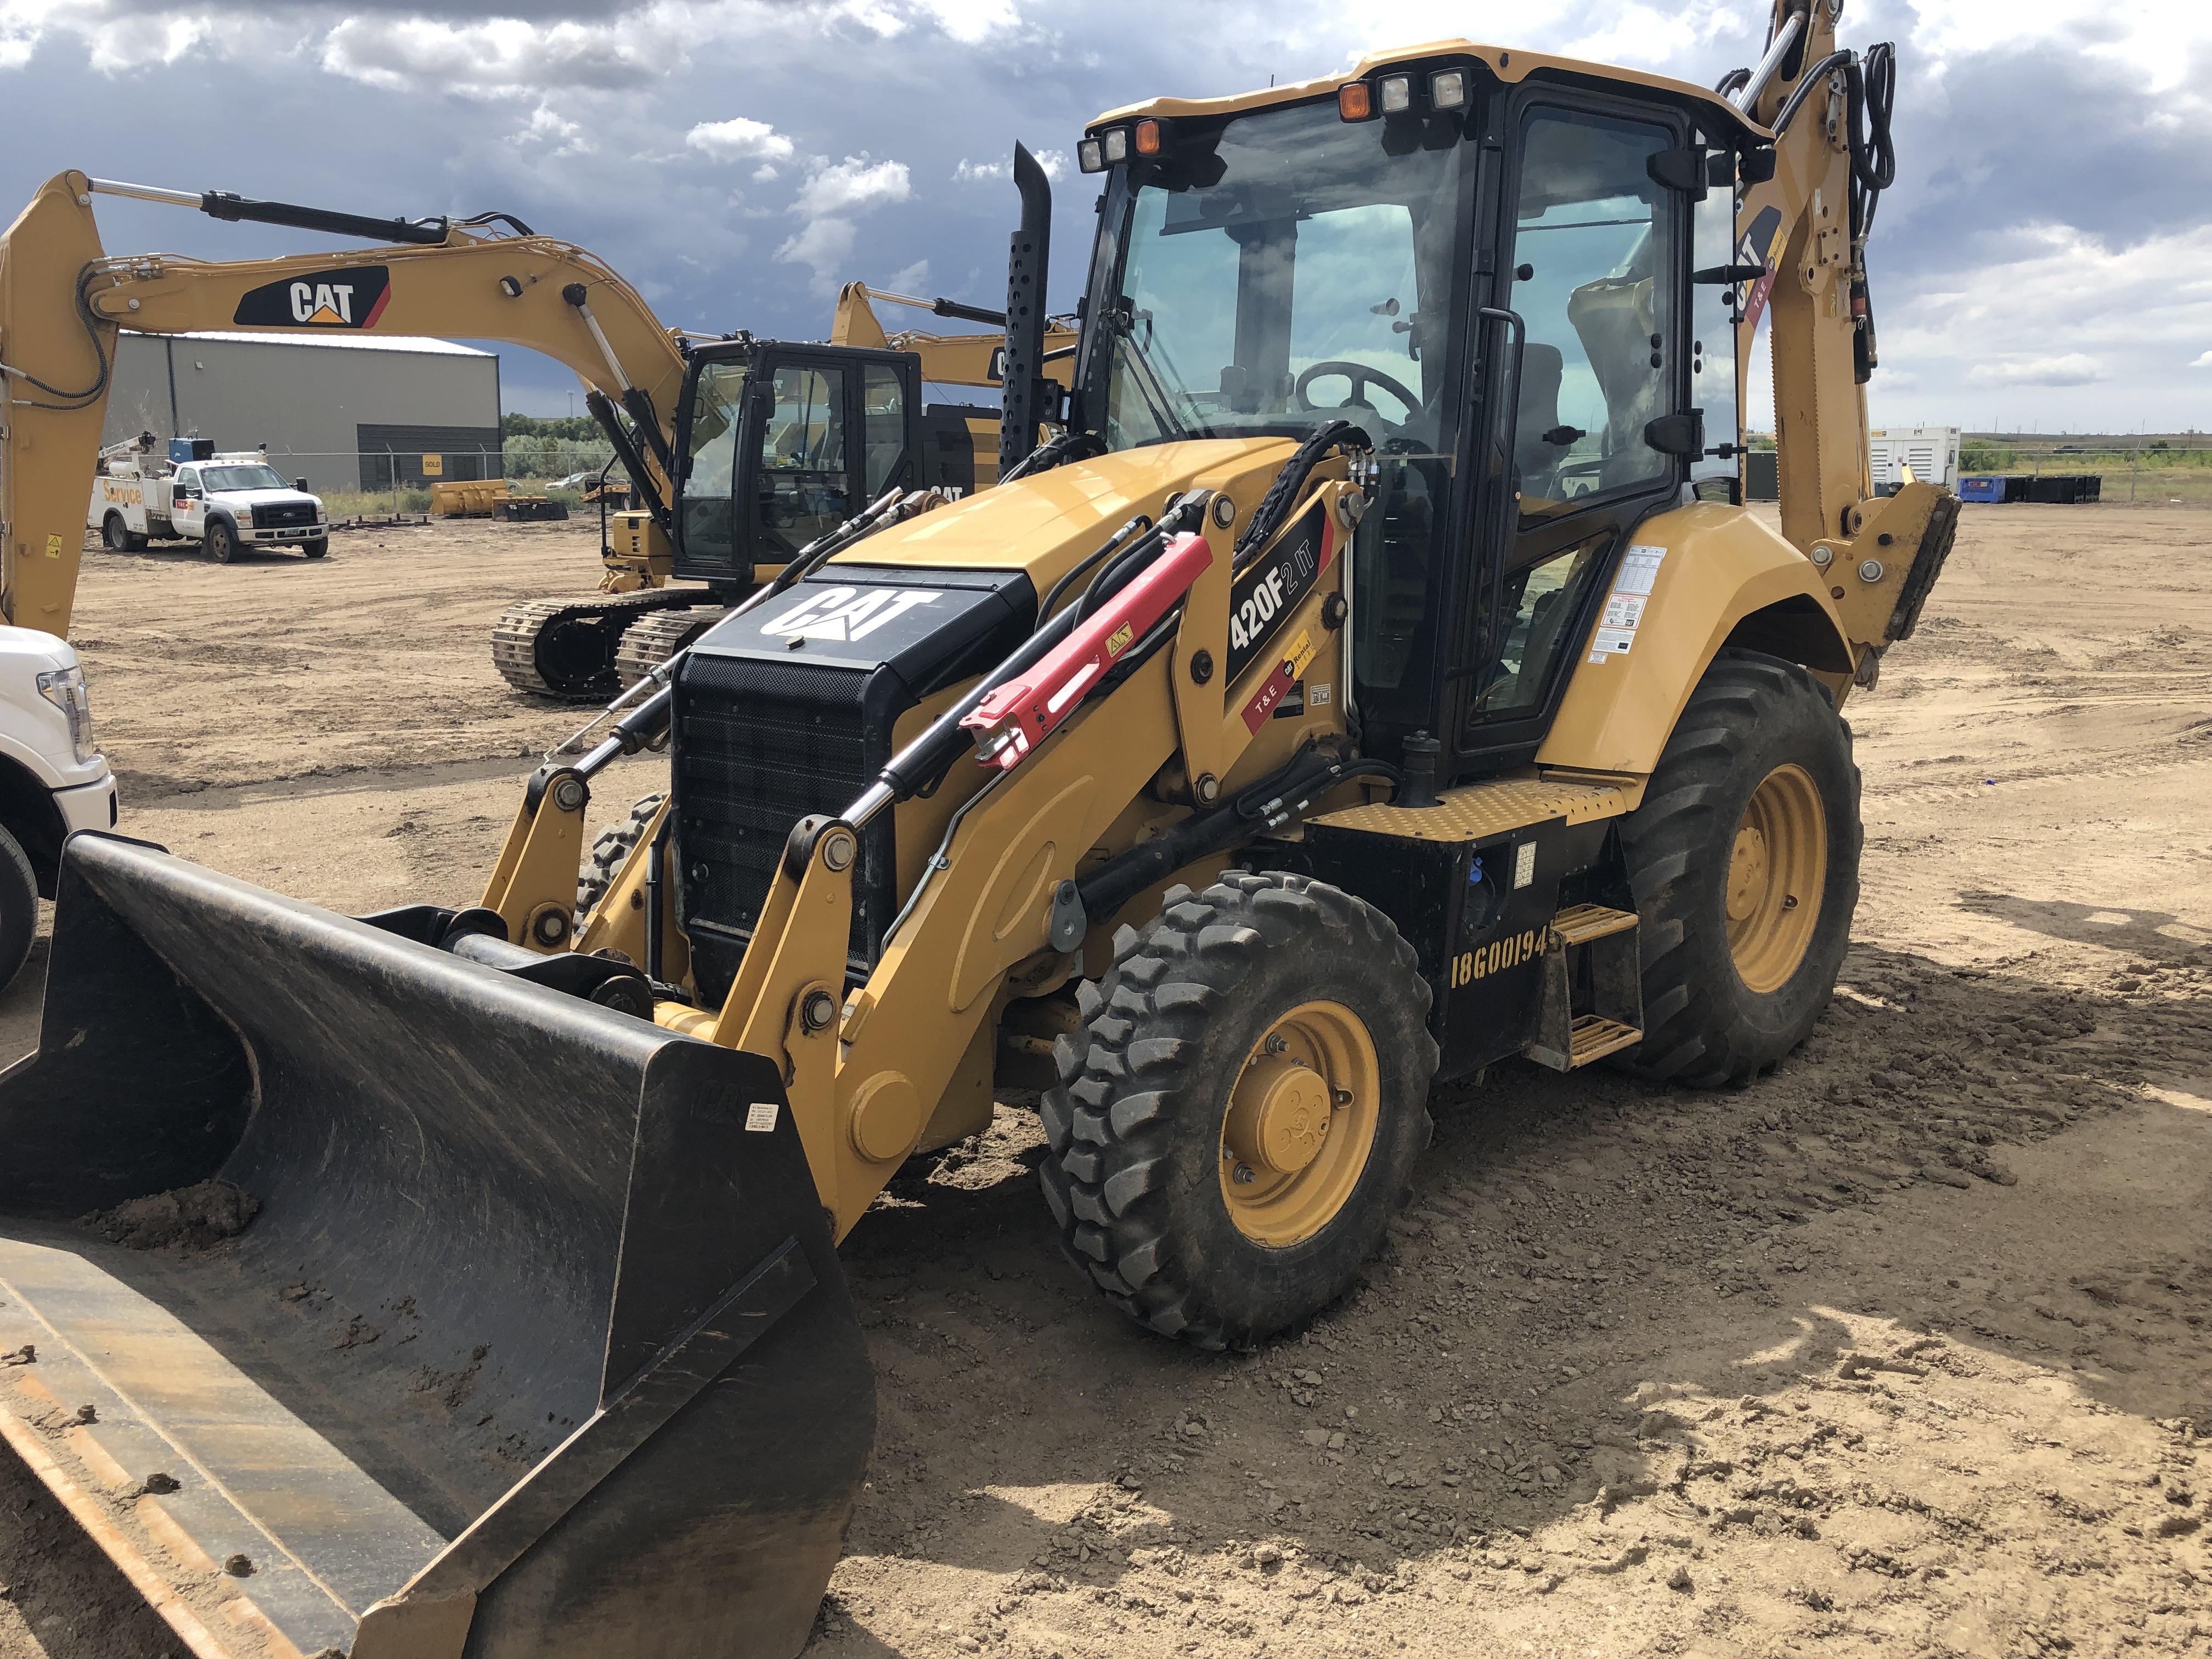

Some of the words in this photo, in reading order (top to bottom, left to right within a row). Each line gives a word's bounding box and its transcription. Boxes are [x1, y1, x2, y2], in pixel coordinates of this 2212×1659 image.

[290, 282, 353, 323] CAT
[103, 479, 142, 505] Service
[1294, 539, 1314, 577] IT
[760, 587, 944, 642] CAT
[1293, 640, 1311, 664] Rental
